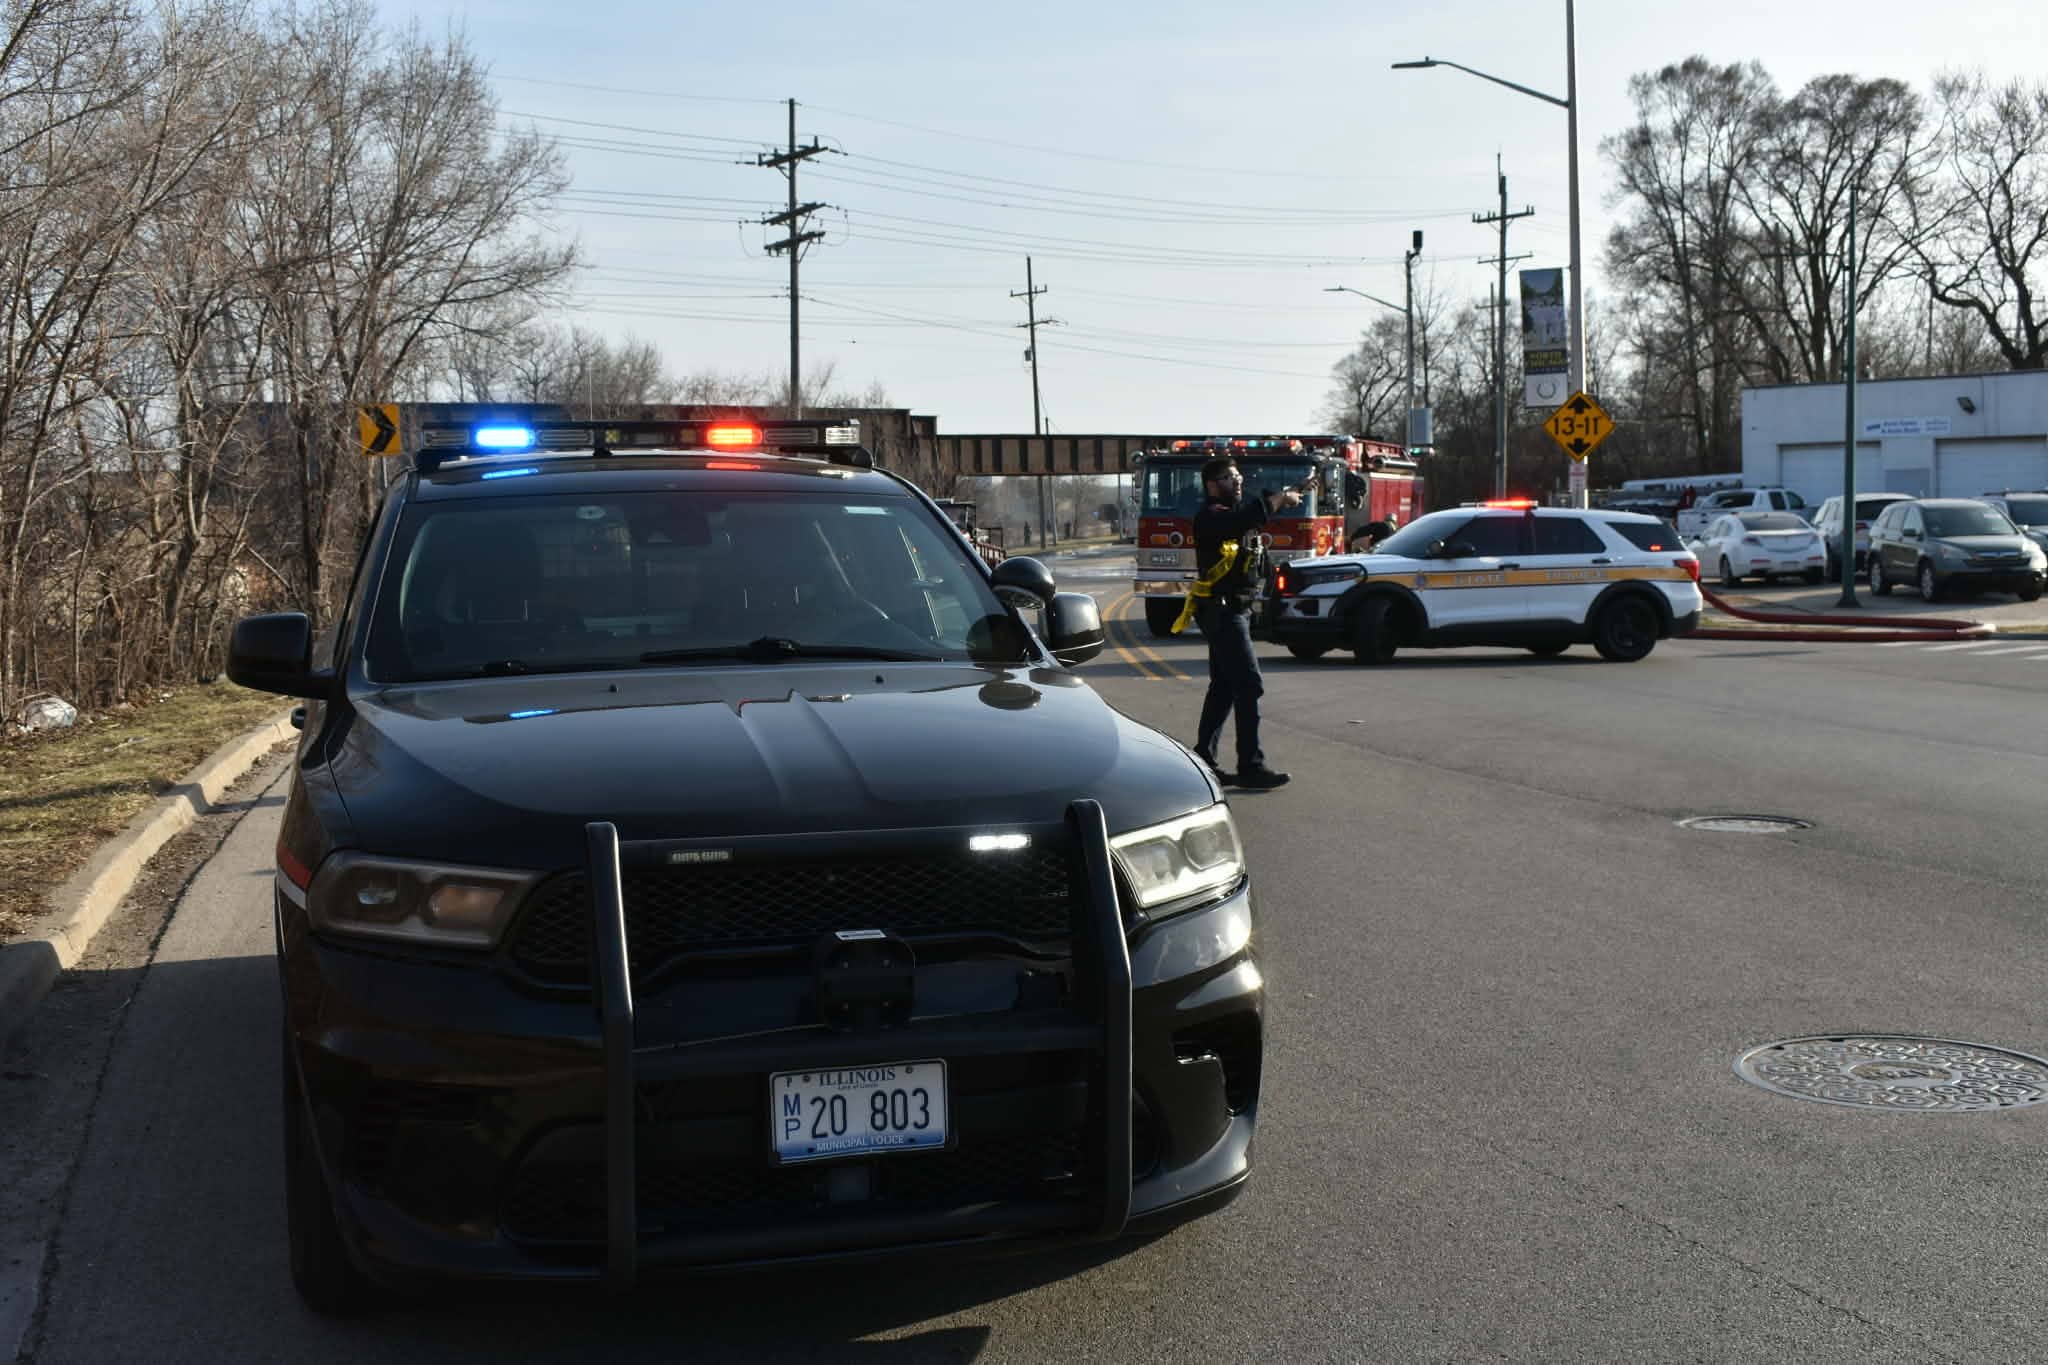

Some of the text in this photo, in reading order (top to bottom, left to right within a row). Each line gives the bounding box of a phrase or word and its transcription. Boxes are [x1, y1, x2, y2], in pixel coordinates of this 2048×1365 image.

[819, 1067, 896, 1087] ILLINOIS
[810, 1088, 930, 1139] 20 803
[816, 1135, 904, 1153] MUNICIPAL POLICE
